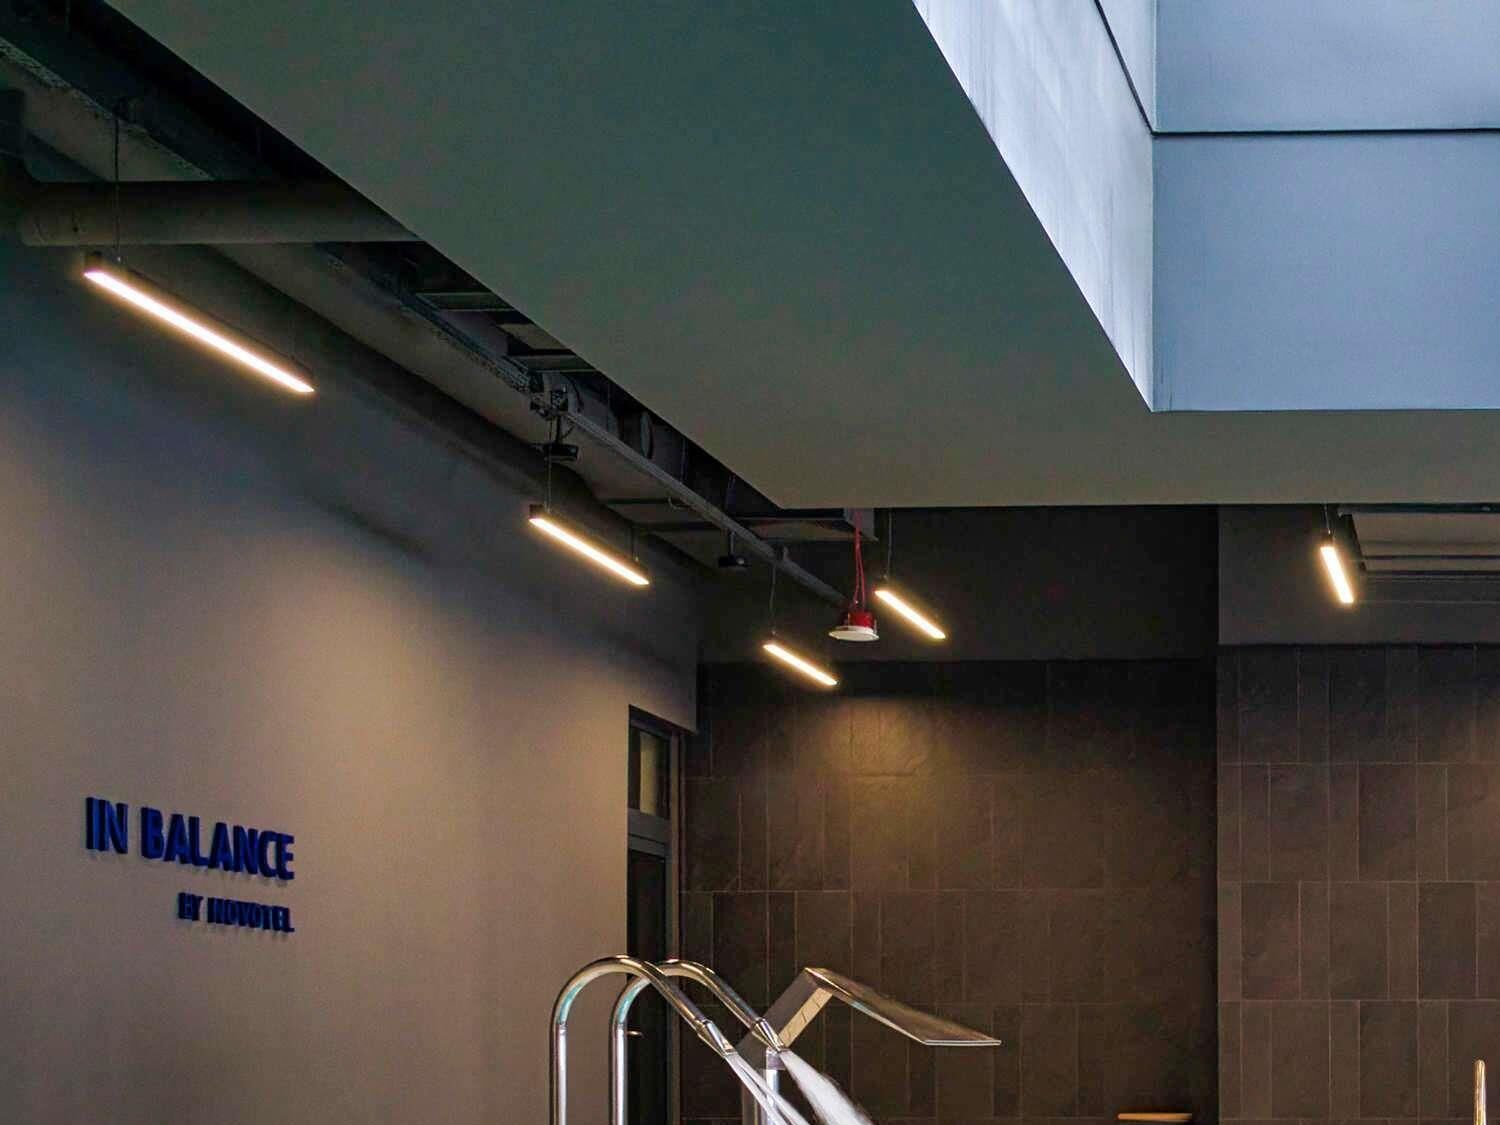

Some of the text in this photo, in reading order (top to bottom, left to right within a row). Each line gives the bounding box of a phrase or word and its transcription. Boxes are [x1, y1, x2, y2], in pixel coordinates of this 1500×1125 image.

[86, 797, 295, 880] IN BALANCE
[178, 892, 295, 933] BY NOVOTEL
